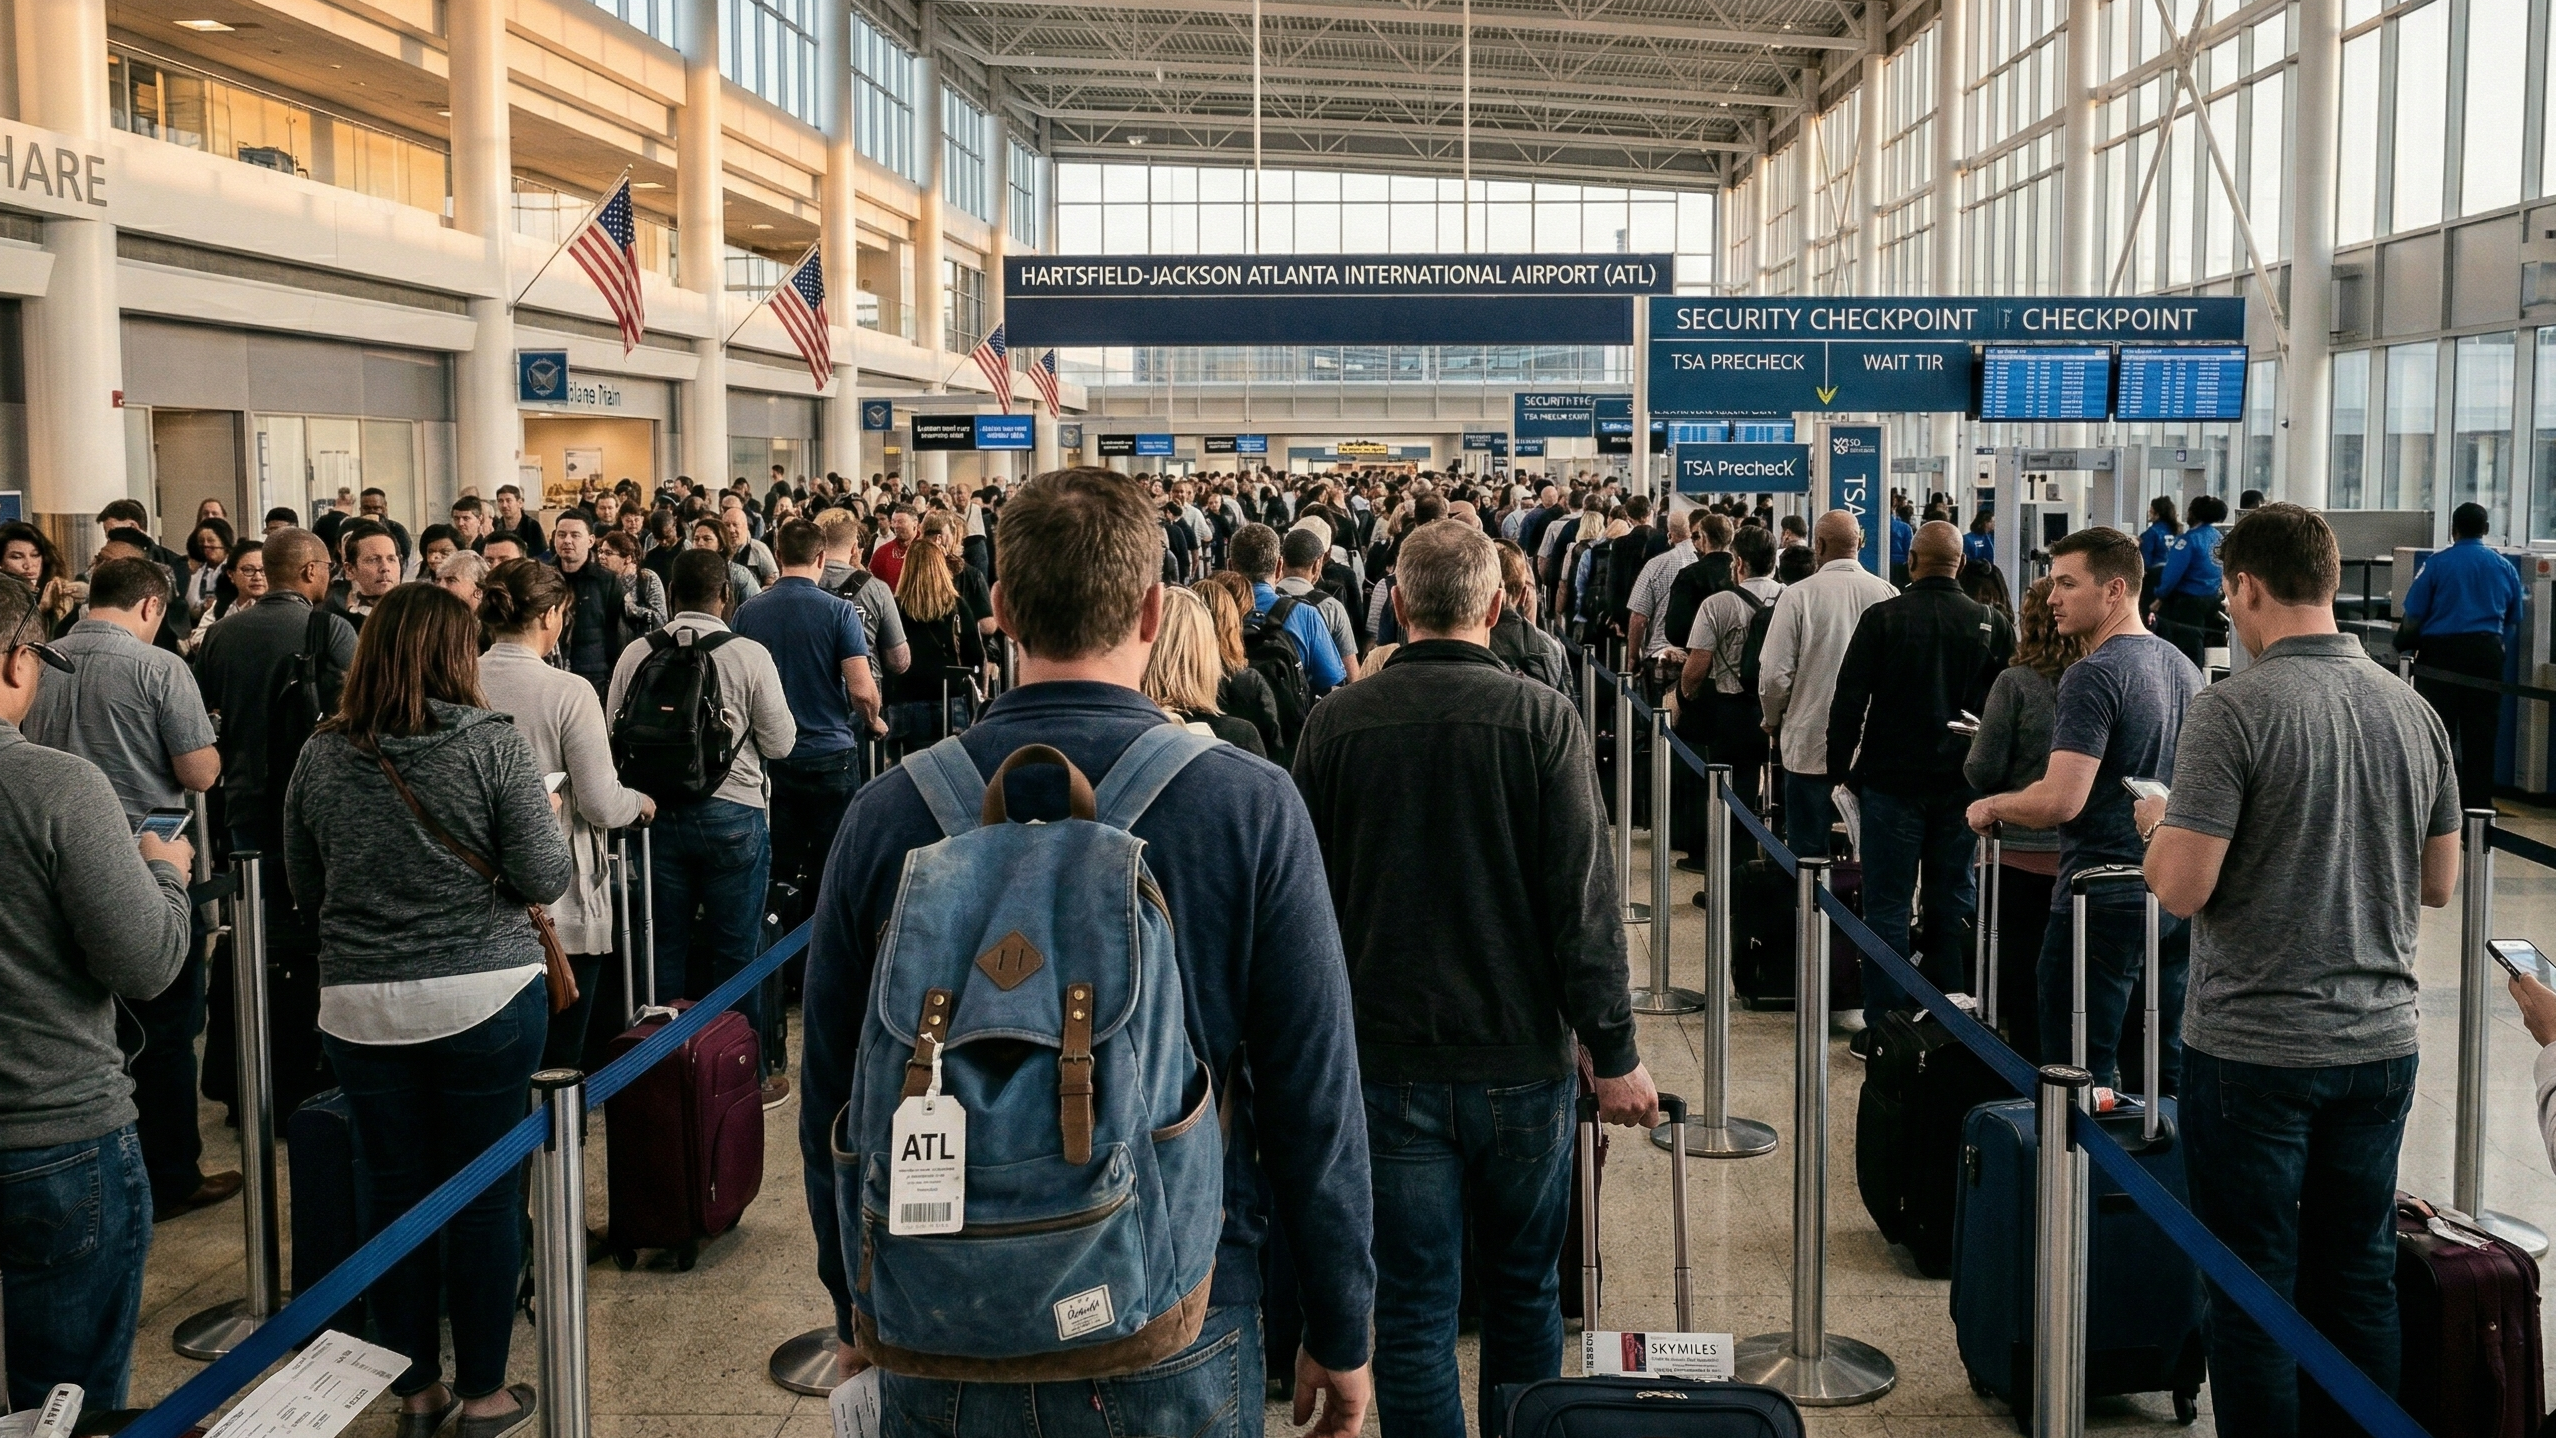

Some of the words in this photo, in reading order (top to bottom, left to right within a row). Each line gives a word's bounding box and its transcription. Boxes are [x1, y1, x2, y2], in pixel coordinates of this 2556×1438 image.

[1021, 265, 1242, 286] HARTSFIELD-JACKSON
[1247, 265, 1339, 286] ATLANTA
[1345, 265, 1506, 285] INTERNATIONAL
[1511, 265, 1600, 285] AIRPORT
[1604, 263, 1657, 287] (ATL)
[1676, 308, 1801, 331] SECURITY
[1810, 308, 1978, 331] CHECKPOINT
[2022, 307, 2198, 331] CHECKPOINT
[1671, 353, 1706, 370] TSA
[1711, 353, 1804, 370] PRECHECK
[1863, 354, 1910, 371] WAIT
[1915, 354, 1943, 371] TIR
[1683, 460, 1714, 476] TSA
[1718, 457, 1797, 476] Precheck
[1844, 473, 1866, 518] TSA
[901, 1133, 955, 1161] ATL
[1651, 1343, 1717, 1355] SKYMILES
